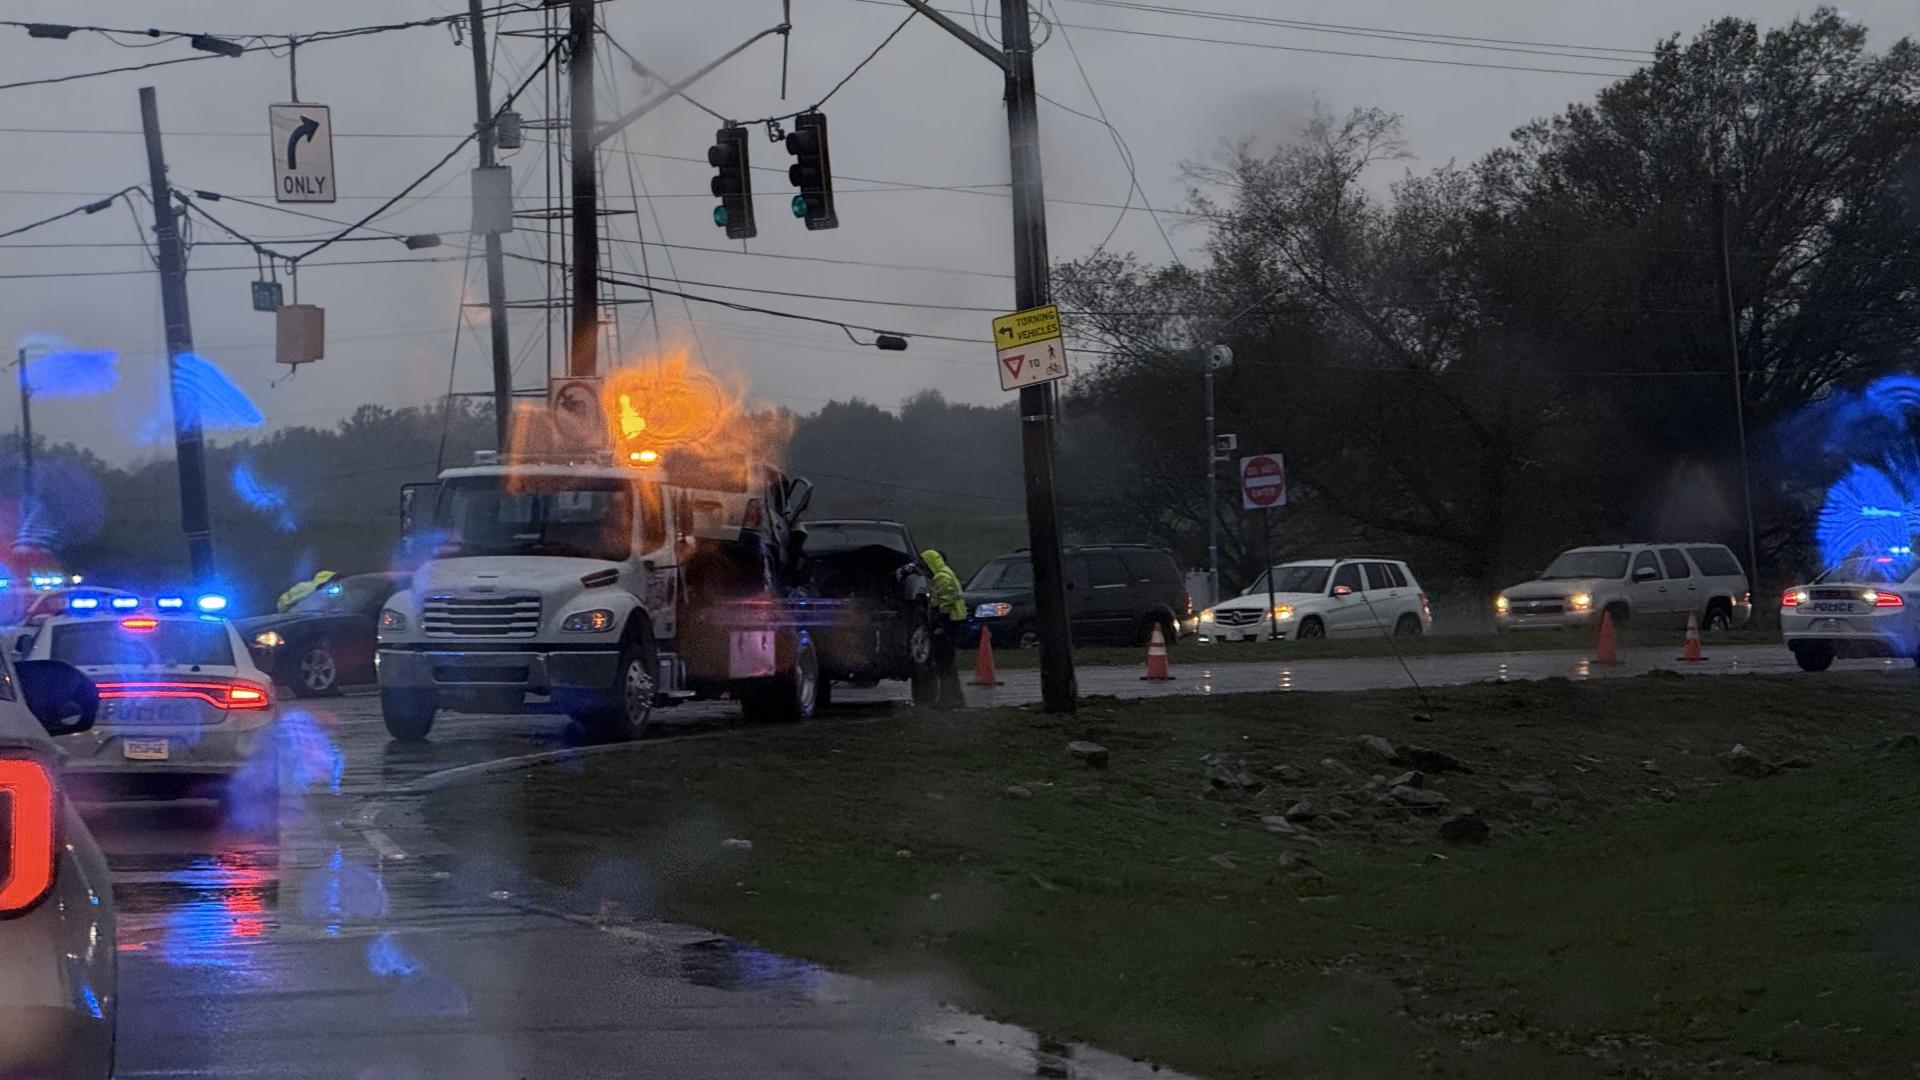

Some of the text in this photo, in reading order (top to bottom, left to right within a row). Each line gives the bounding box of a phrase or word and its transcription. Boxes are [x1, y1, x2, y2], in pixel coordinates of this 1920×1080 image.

[284, 176, 325, 194] ONLY
[1016, 311, 1055, 327] TURNING
[1017, 323, 1058, 340] VEHICLES
[1029, 358, 1041, 368] TO
